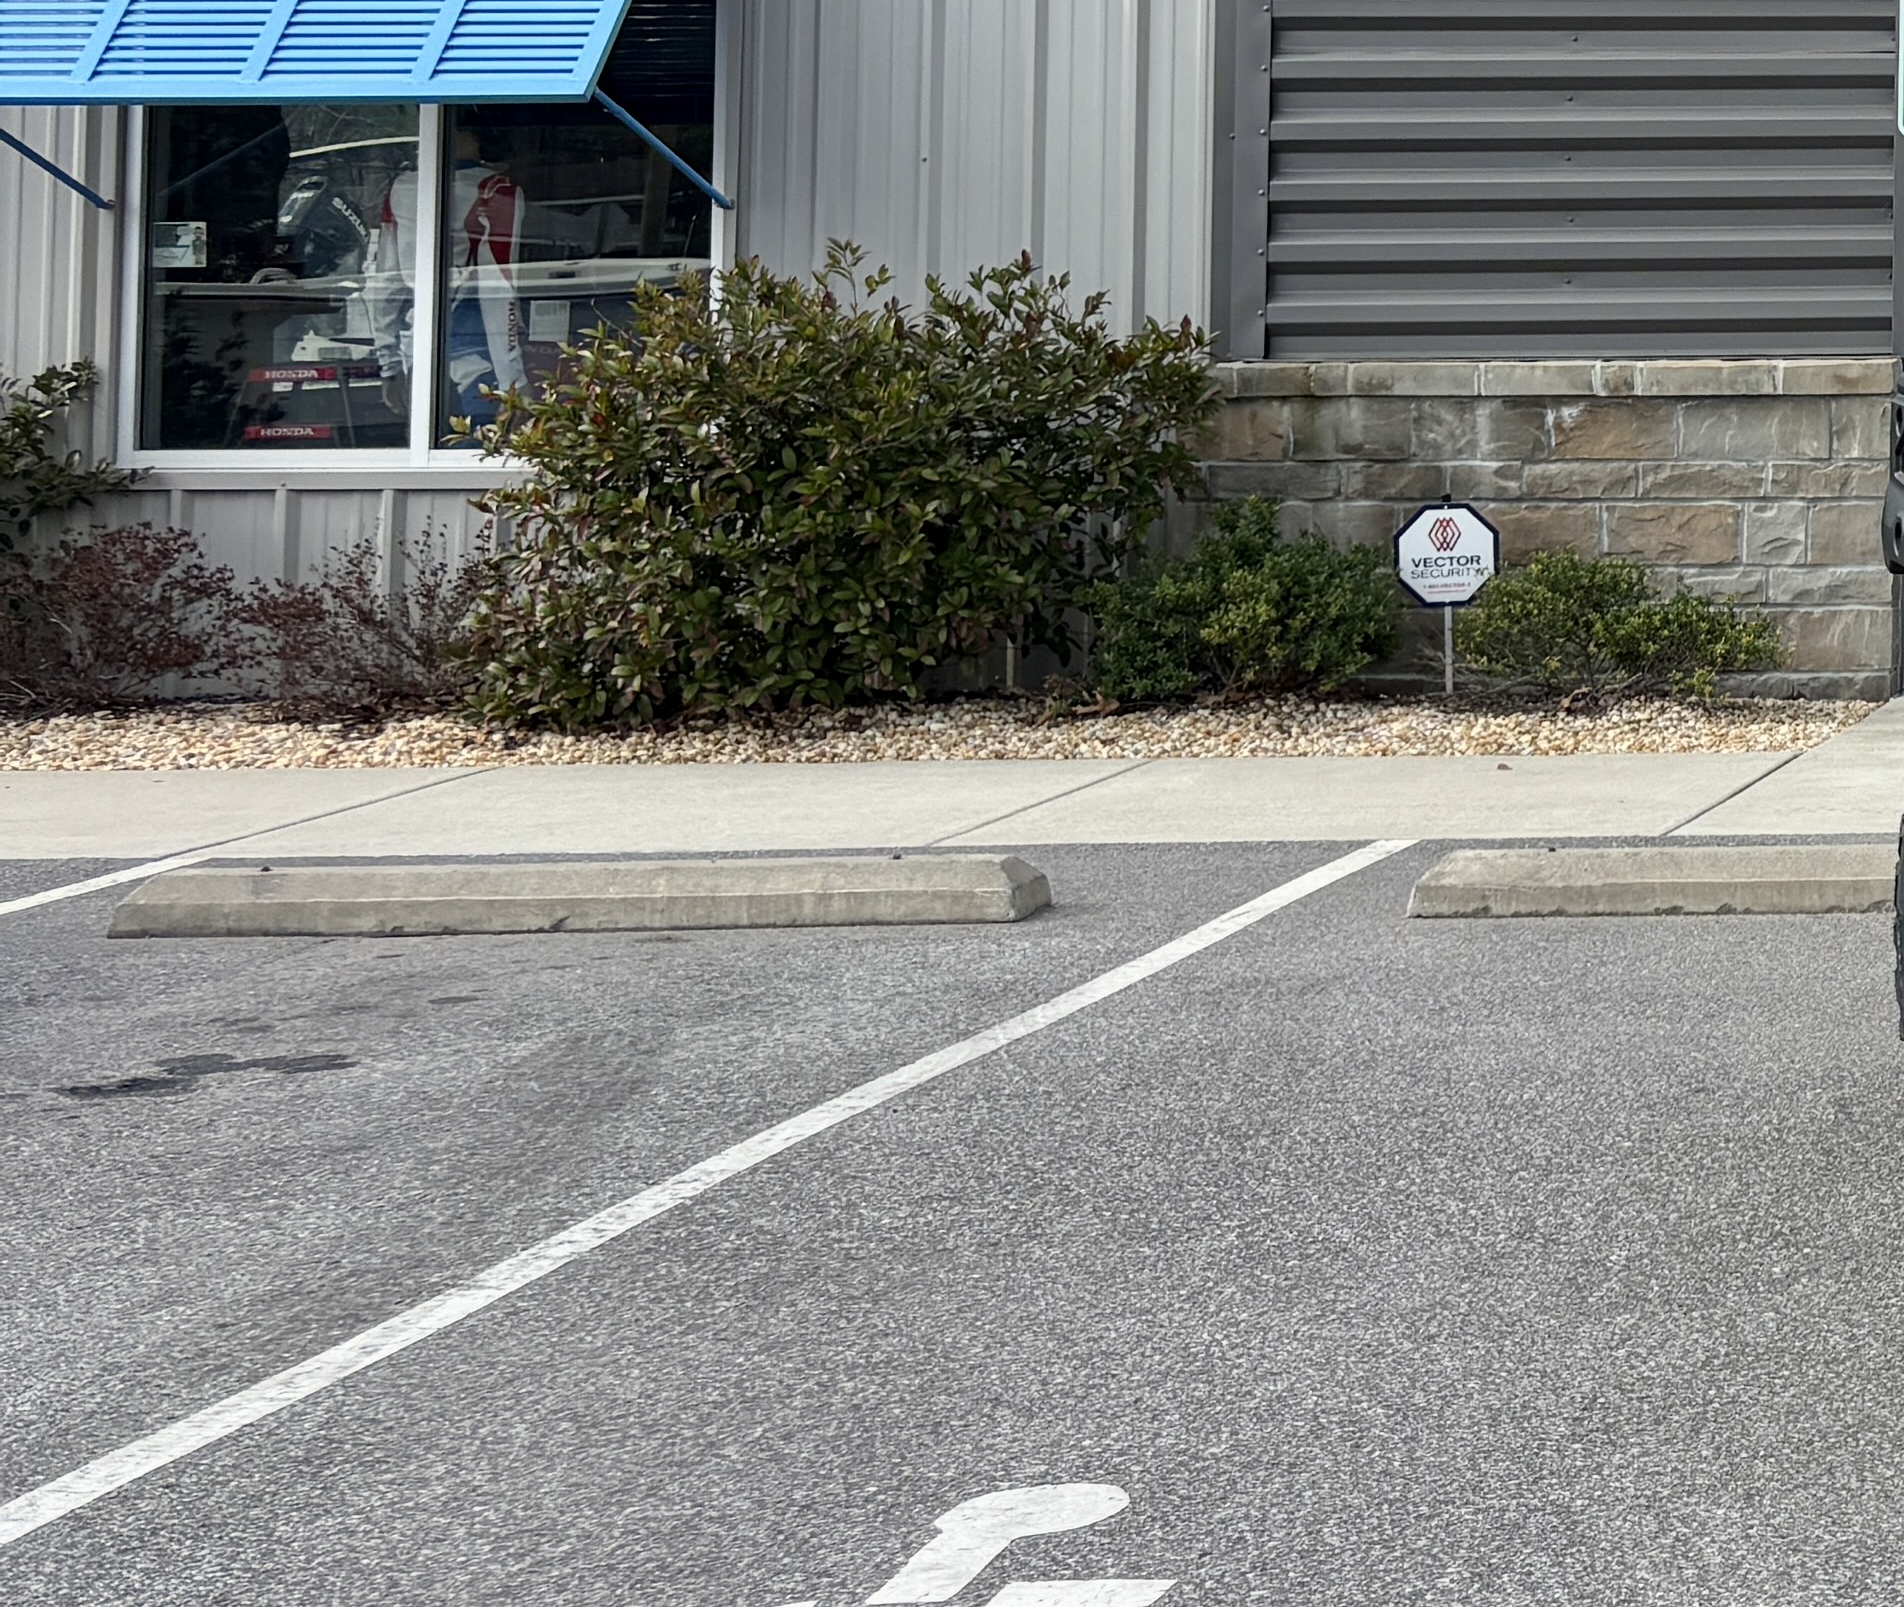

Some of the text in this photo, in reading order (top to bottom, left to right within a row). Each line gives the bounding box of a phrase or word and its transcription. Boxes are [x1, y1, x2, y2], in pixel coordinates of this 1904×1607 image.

[265, 369, 319, 380] HONDA
[260, 427, 315, 437] HONDA
[1411, 555, 1481, 568] VECTOR
[1411, 567, 1482, 579] SECURITY
